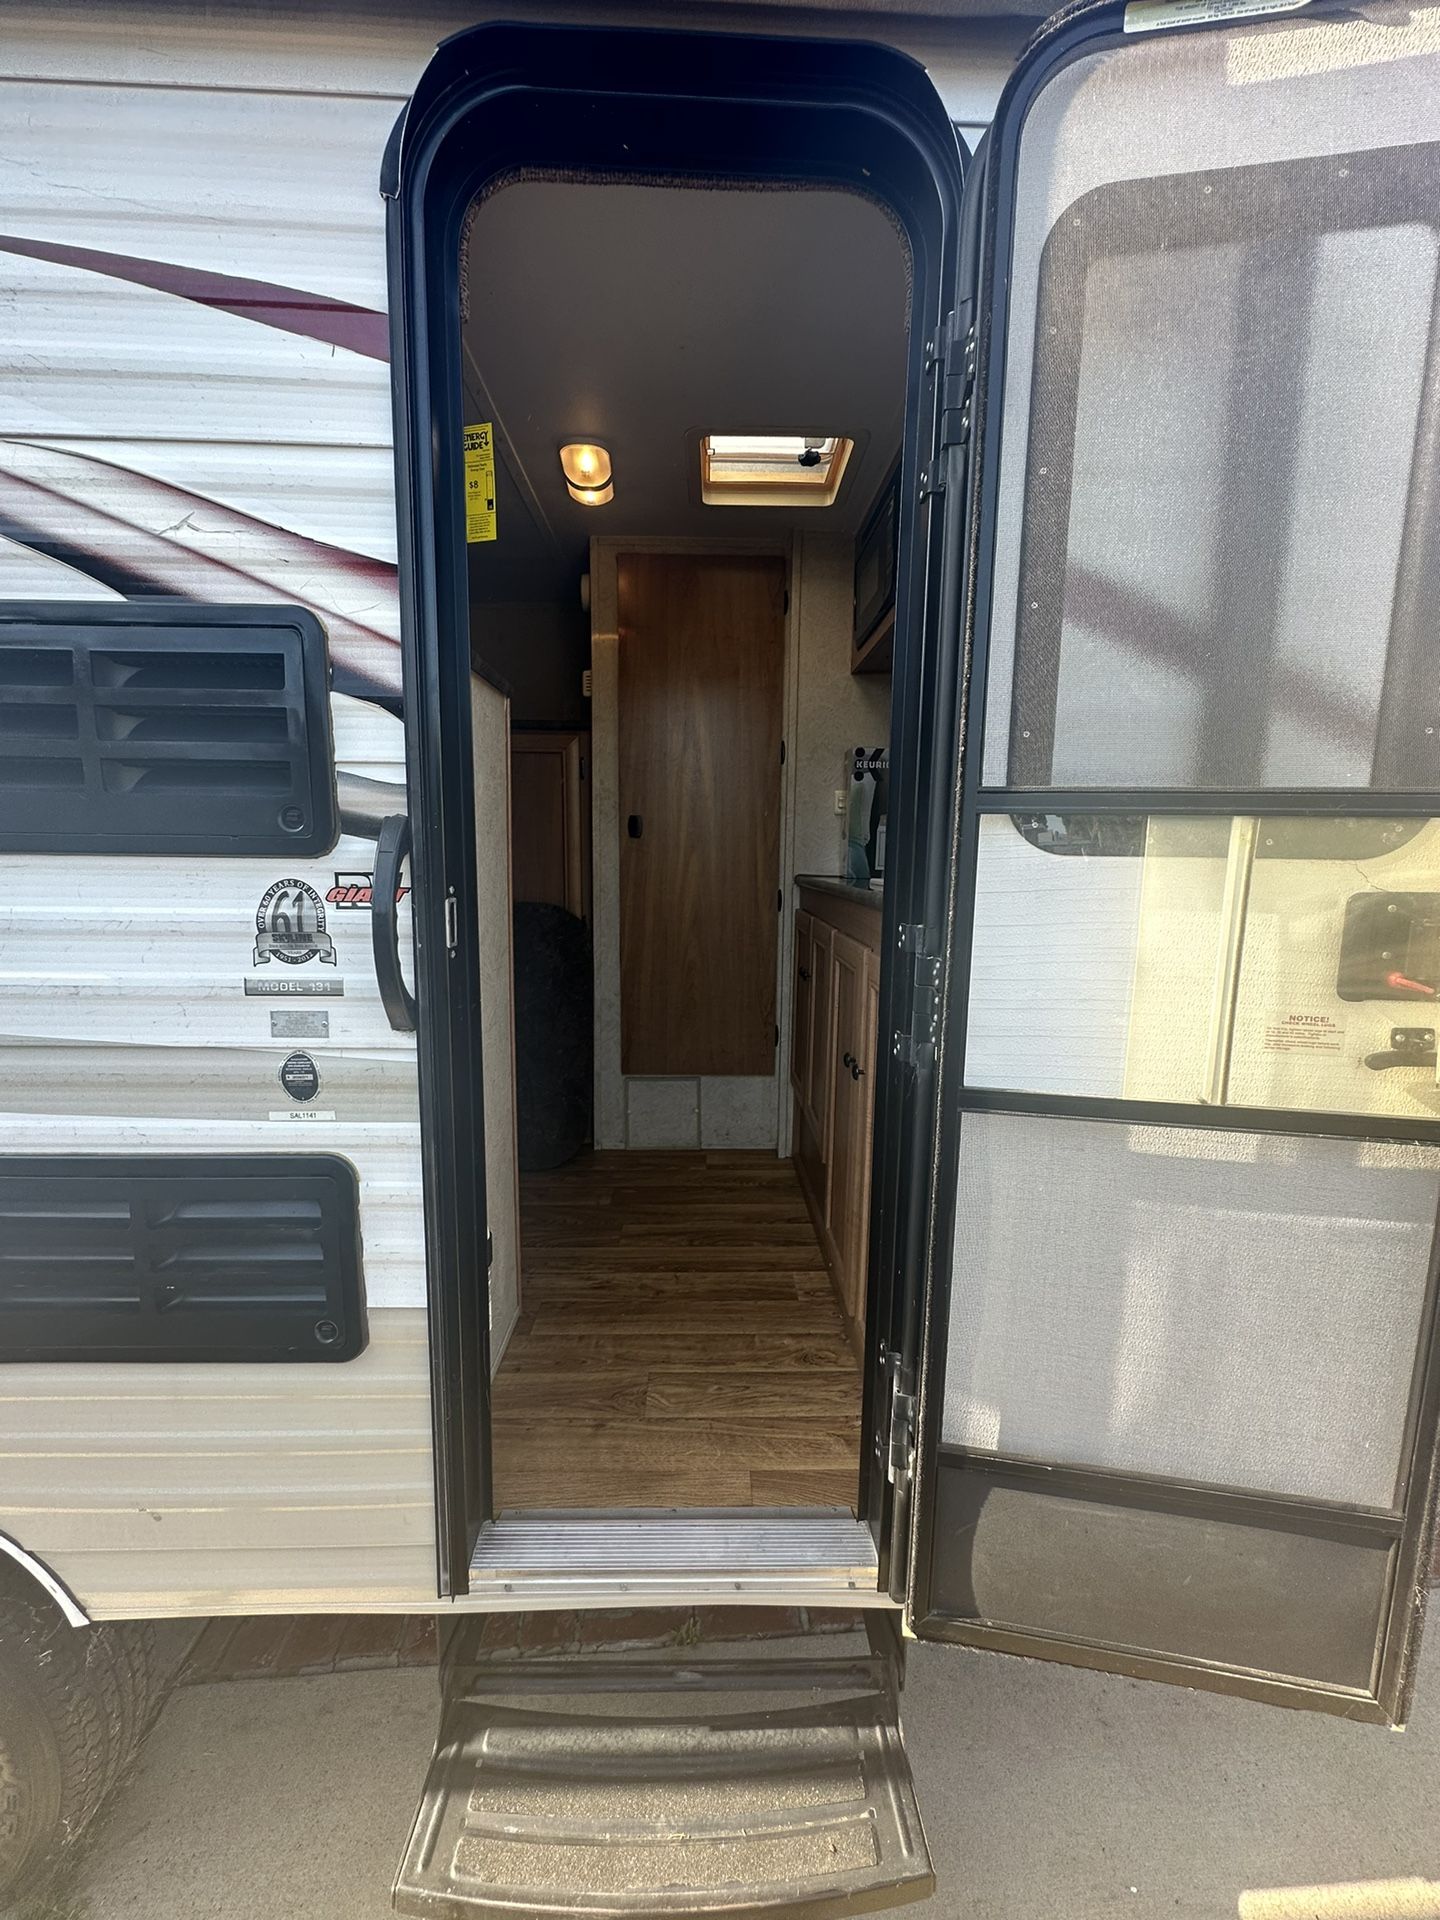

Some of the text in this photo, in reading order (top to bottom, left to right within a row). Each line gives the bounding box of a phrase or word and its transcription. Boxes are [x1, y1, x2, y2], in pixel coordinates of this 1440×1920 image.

[326, 887, 412, 903] GIAT
[258, 879, 325, 933] OVER 60 YEARS OF INTEGRITY
[272, 890, 304, 933] 61
[258, 982, 303, 991] MODEL
[1289, 1014, 1330, 1023] NOTICE!
